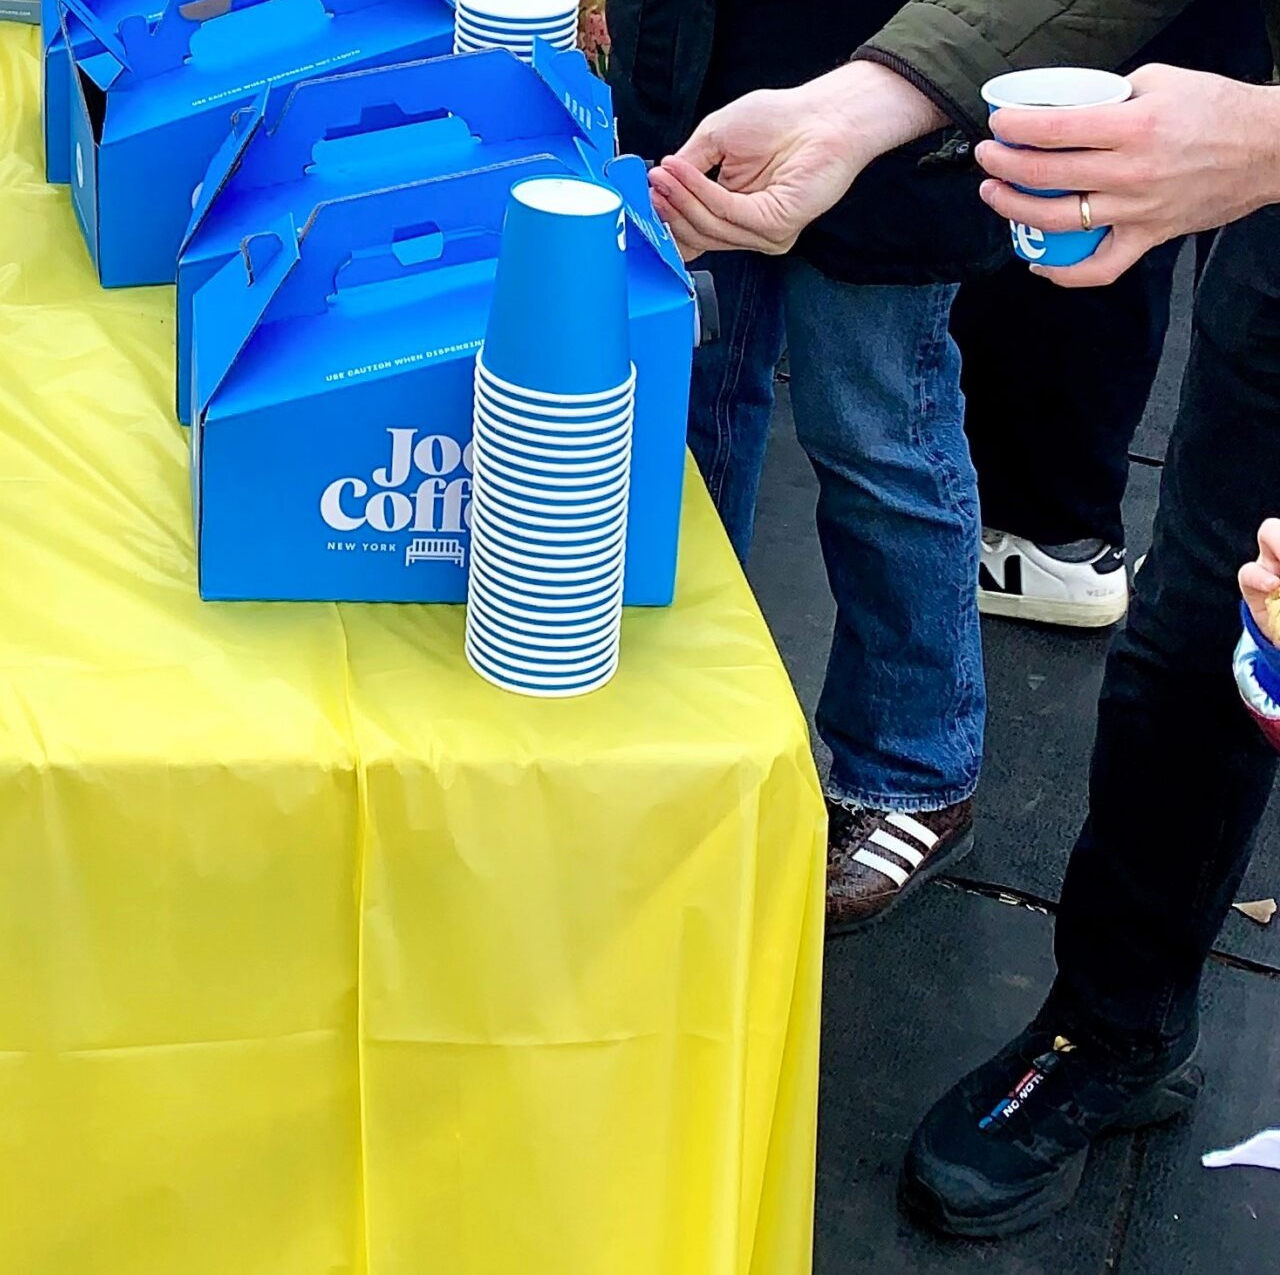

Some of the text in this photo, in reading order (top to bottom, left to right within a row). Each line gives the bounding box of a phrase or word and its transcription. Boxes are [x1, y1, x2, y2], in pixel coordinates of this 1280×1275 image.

[208, 87, 242, 101] CAUTION
[325, 372, 345, 382] USE
[347, 362, 392, 377] CAUTION
[394, 353, 424, 366] WHEN
[320, 477, 473, 532] Coff
[327, 541, 396, 552] NEW YORK
